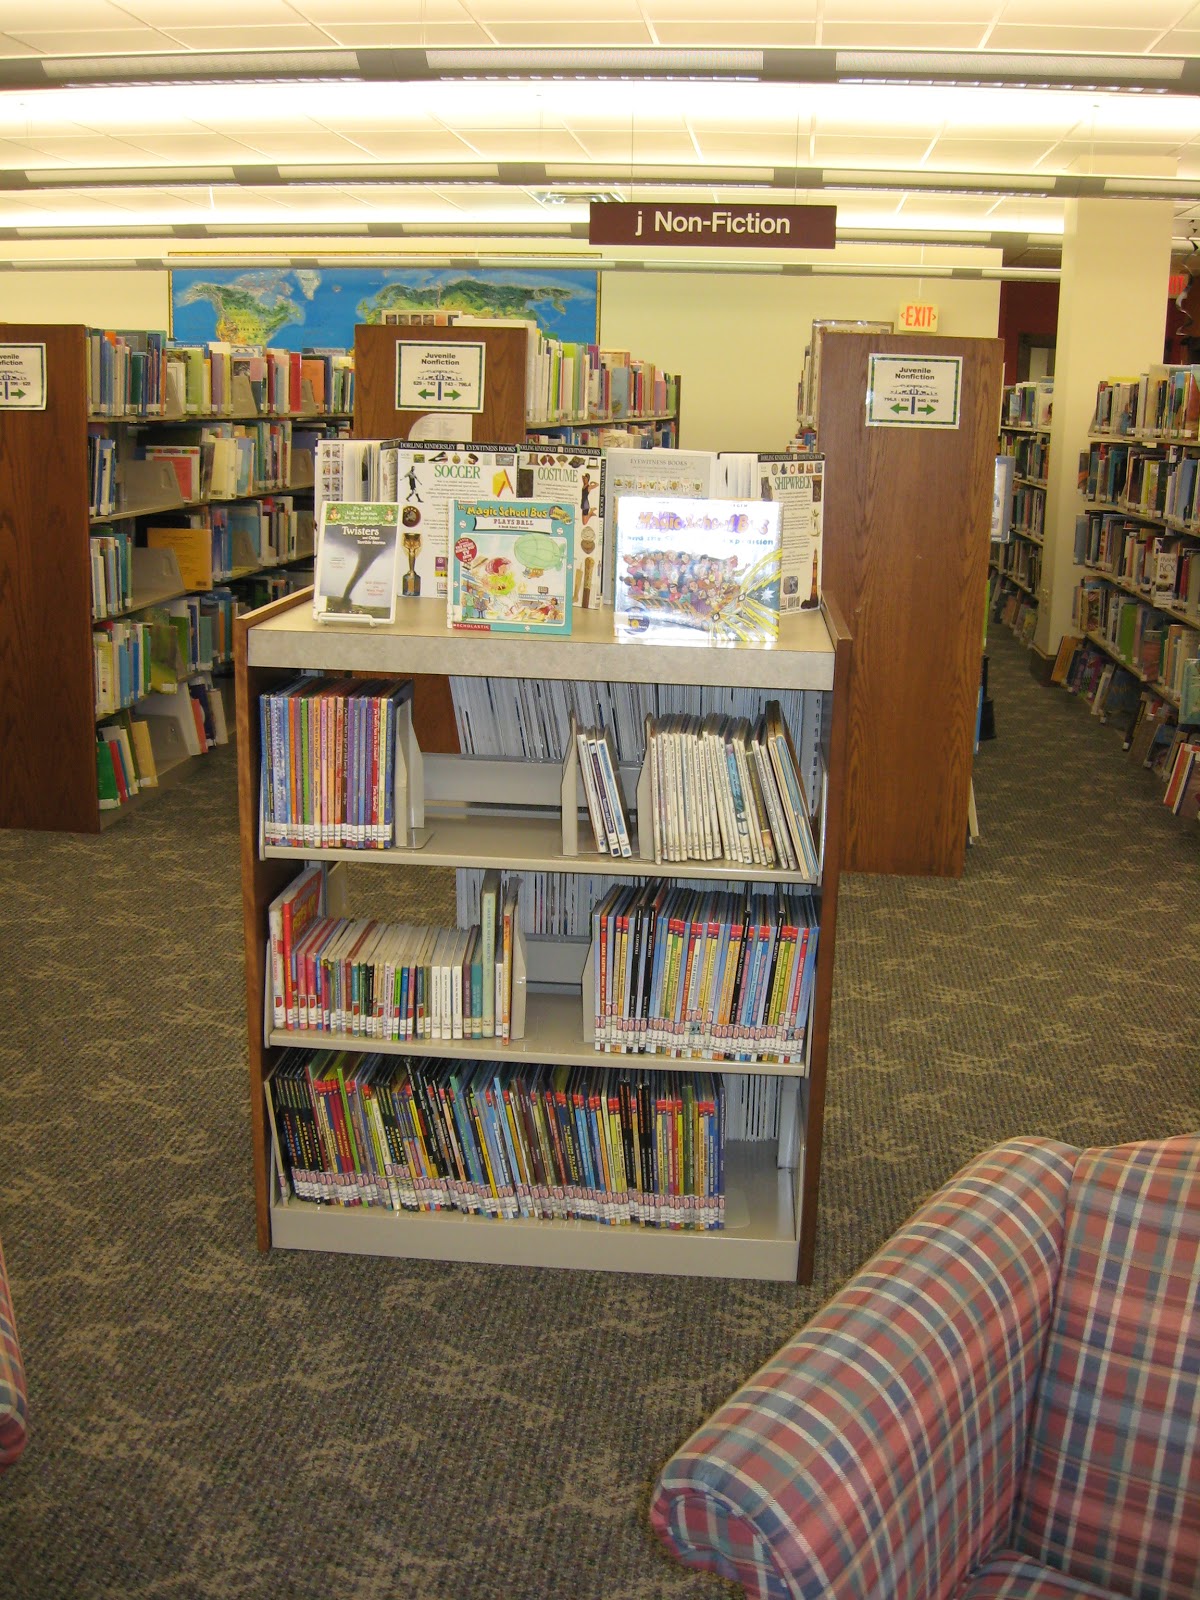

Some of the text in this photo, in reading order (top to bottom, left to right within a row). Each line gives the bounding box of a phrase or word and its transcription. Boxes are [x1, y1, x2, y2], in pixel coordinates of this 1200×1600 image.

[635, 211, 790, 236] j Non-Fiction
[905, 305, 933, 328] EXIT
[895, 373, 935, 381] Nonfiction
[466, 444, 498, 452] EYEWITNESS
[630, 458, 666, 466] EYEWITNESS
[434, 464, 480, 478] SOCCER
[538, 467, 578, 482] COSTUME
[774, 476, 812, 490] SHIPWRECK
[466, 506, 498, 518] Magic
[498, 506, 529, 517] School
[530, 508, 548, 518] Bus
[638, 512, 682, 533] Magic
[342, 526, 380, 536] Twisters
